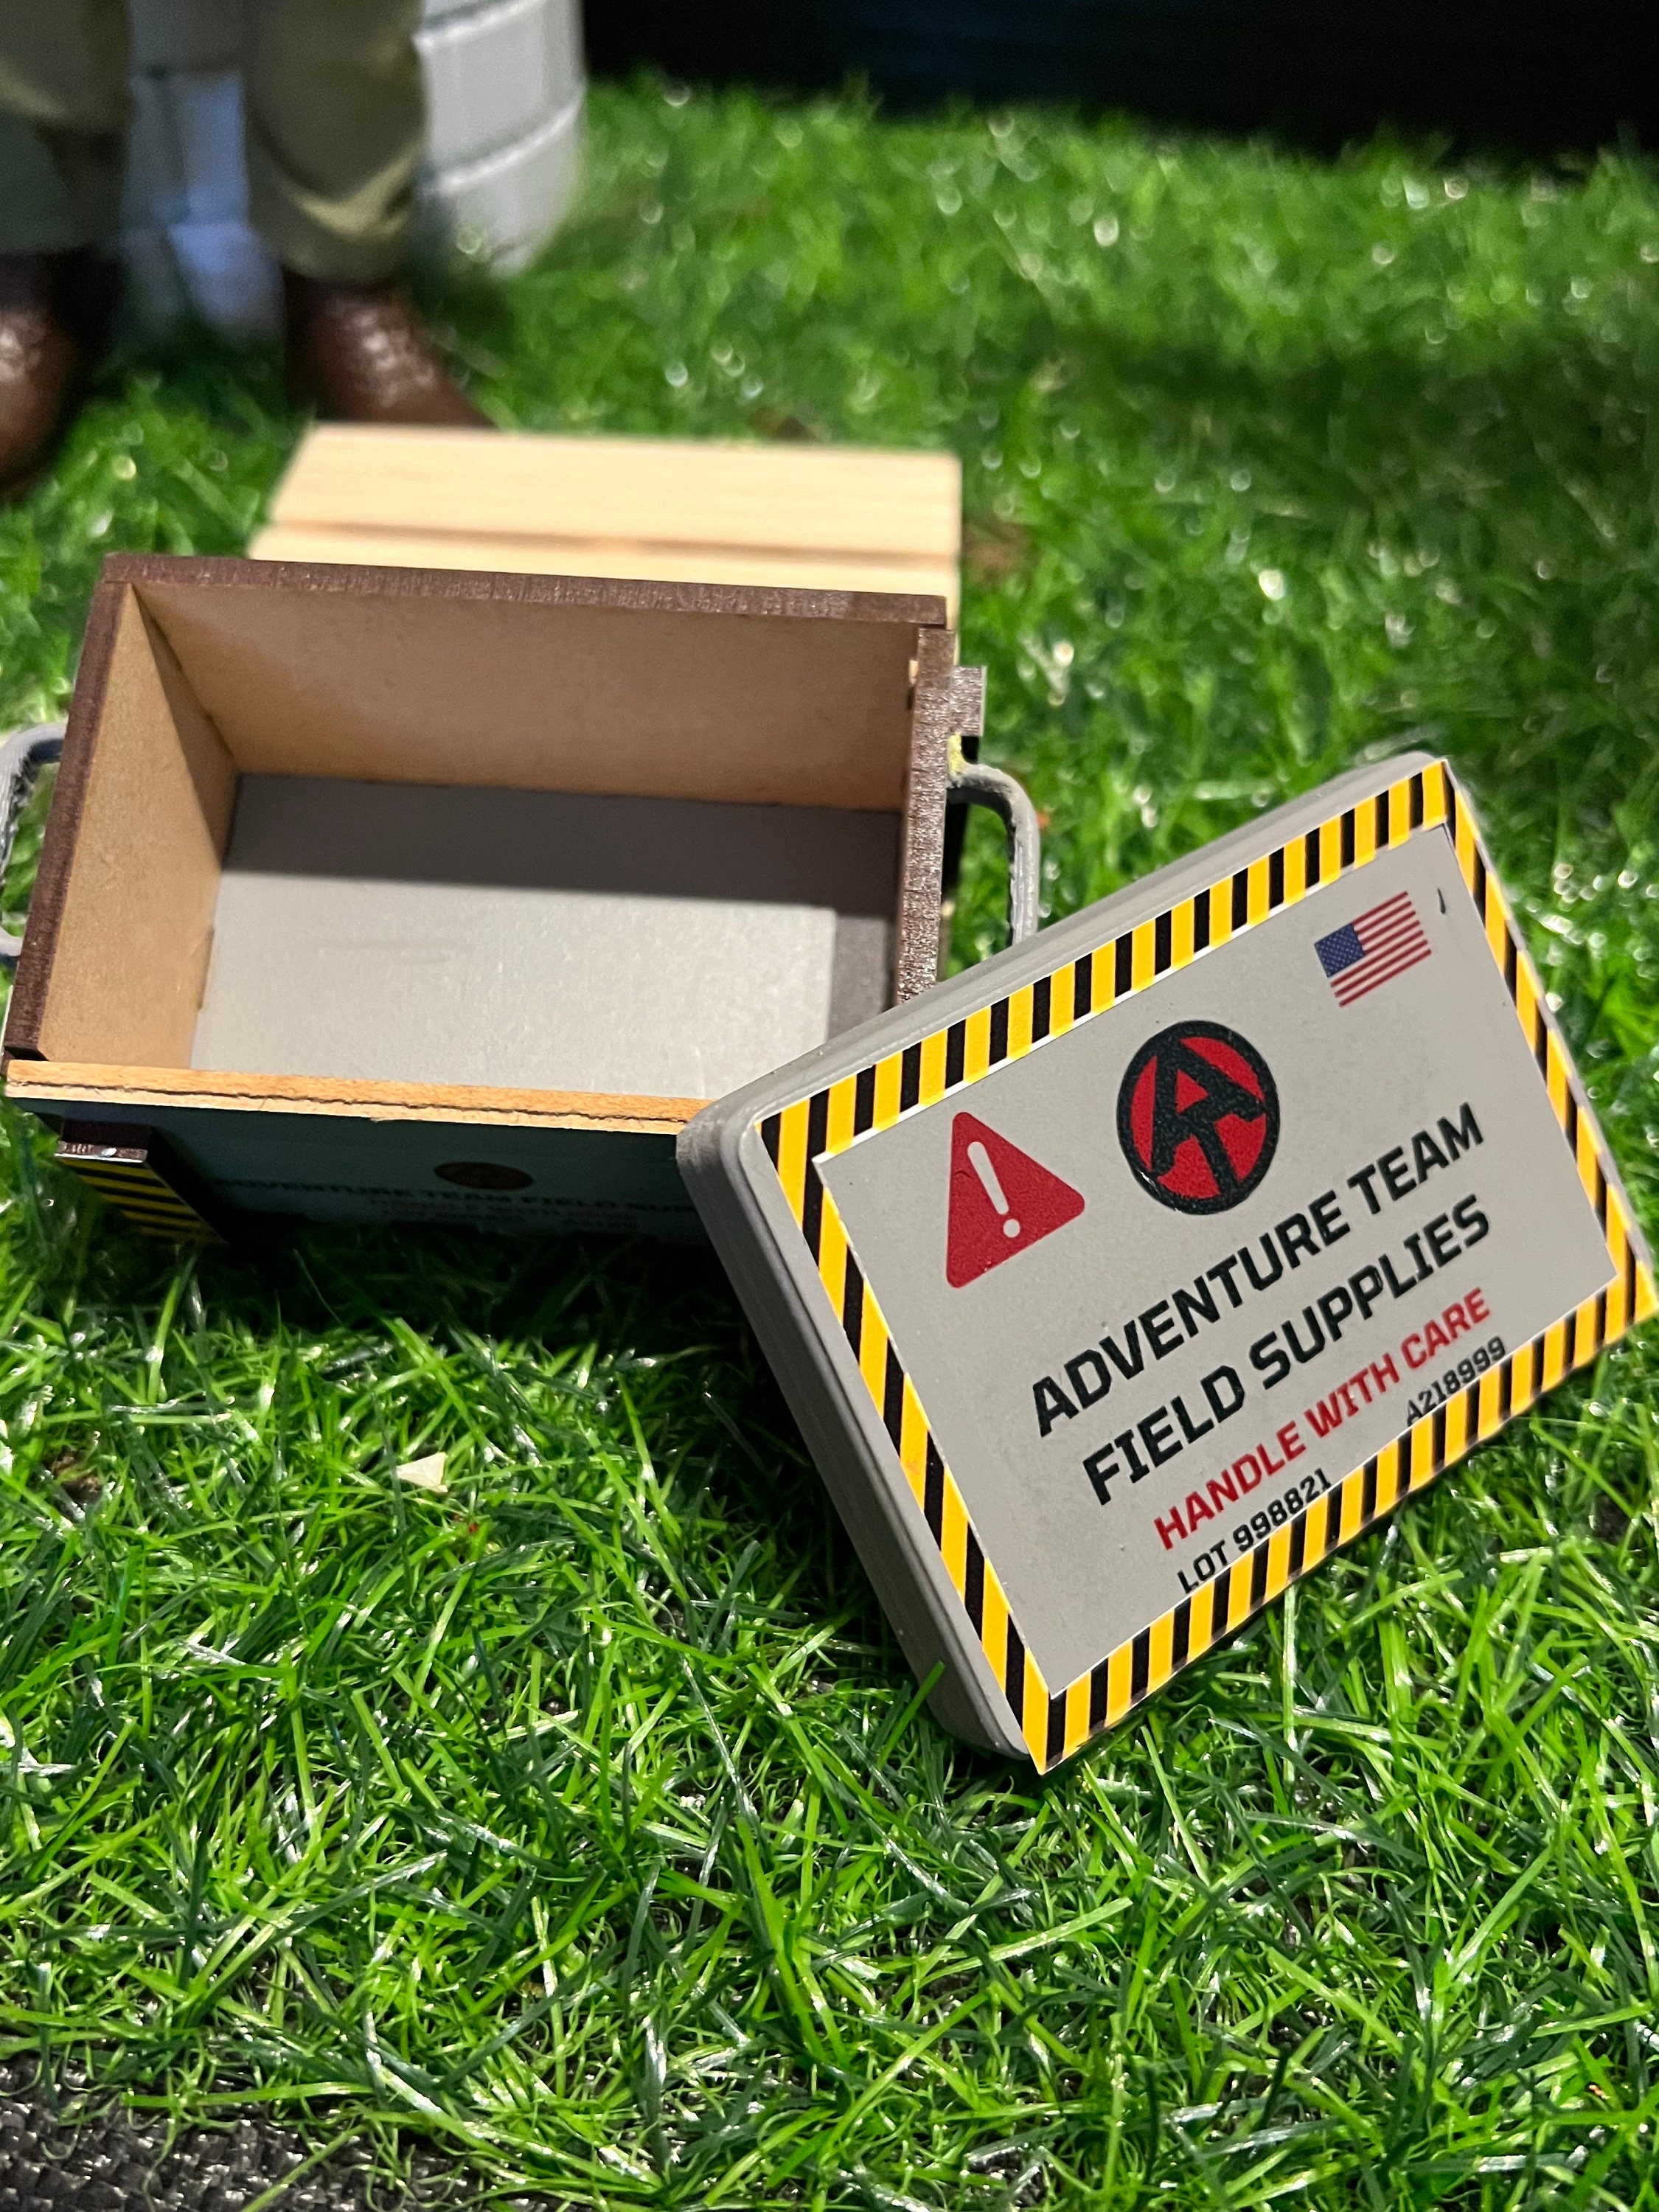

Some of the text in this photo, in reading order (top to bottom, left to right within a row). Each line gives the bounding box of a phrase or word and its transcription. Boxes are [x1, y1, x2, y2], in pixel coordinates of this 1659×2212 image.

[1032, 1102, 1484, 1438] ADVENTURE TEAM
[1082, 1194, 1489, 1506] FIELD SUPPLIES
[1407, 1336, 1506, 1427] A218999
[1154, 1287, 1490, 1551] HANDLE WITH CARE
[1177, 1467, 1331, 1594] LOT 998821
